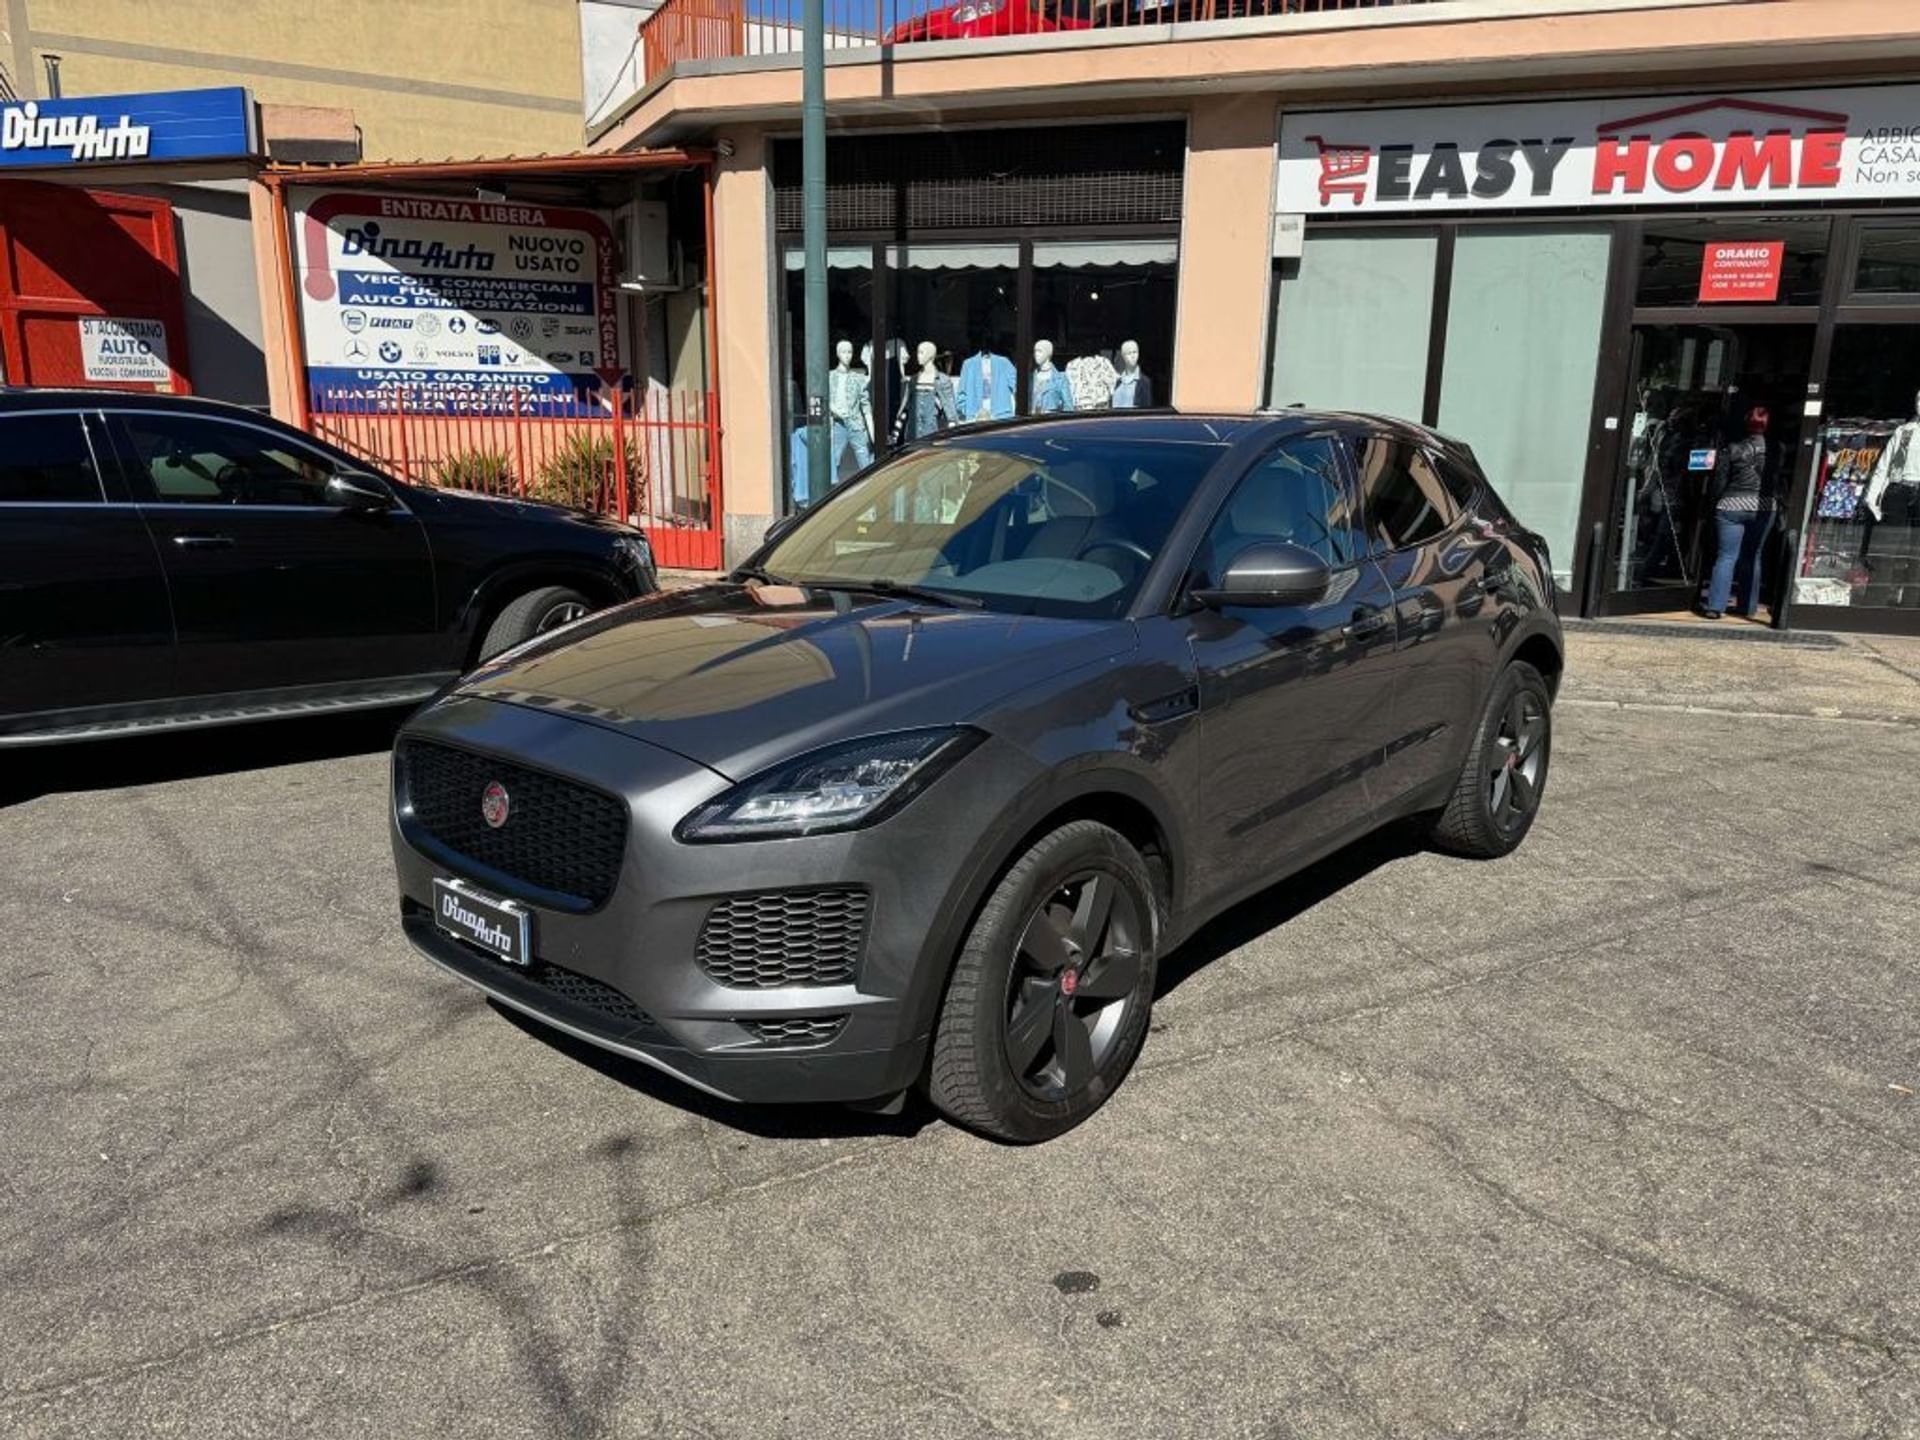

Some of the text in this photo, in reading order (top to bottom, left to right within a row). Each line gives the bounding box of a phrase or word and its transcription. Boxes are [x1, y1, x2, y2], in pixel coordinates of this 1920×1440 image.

[1375, 126, 1846, 202] EASY HOME
[1859, 146, 1920, 165] CASA
[1856, 167, 1899, 184] Non
[381, 199, 546, 226] ENTRATA LIBERA
[508, 234, 584, 255] NUOVO
[1715, 247, 1770, 259] ORARIO
[515, 255, 579, 273] USATO
[353, 273, 577, 294] VEICOLI COMMERCIALI
[399, 286, 539, 301] FUORISTRADA
[348, 293, 585, 313] AUTO D'IMPORTAZIONE
[83, 319, 163, 338] SI ACQUISTANO
[369, 316, 413, 329] FIAT
[101, 338, 152, 355] AUTO
[357, 370, 550, 384] USATO GARANTITO
[377, 380, 475, 391] ANTICIPO
